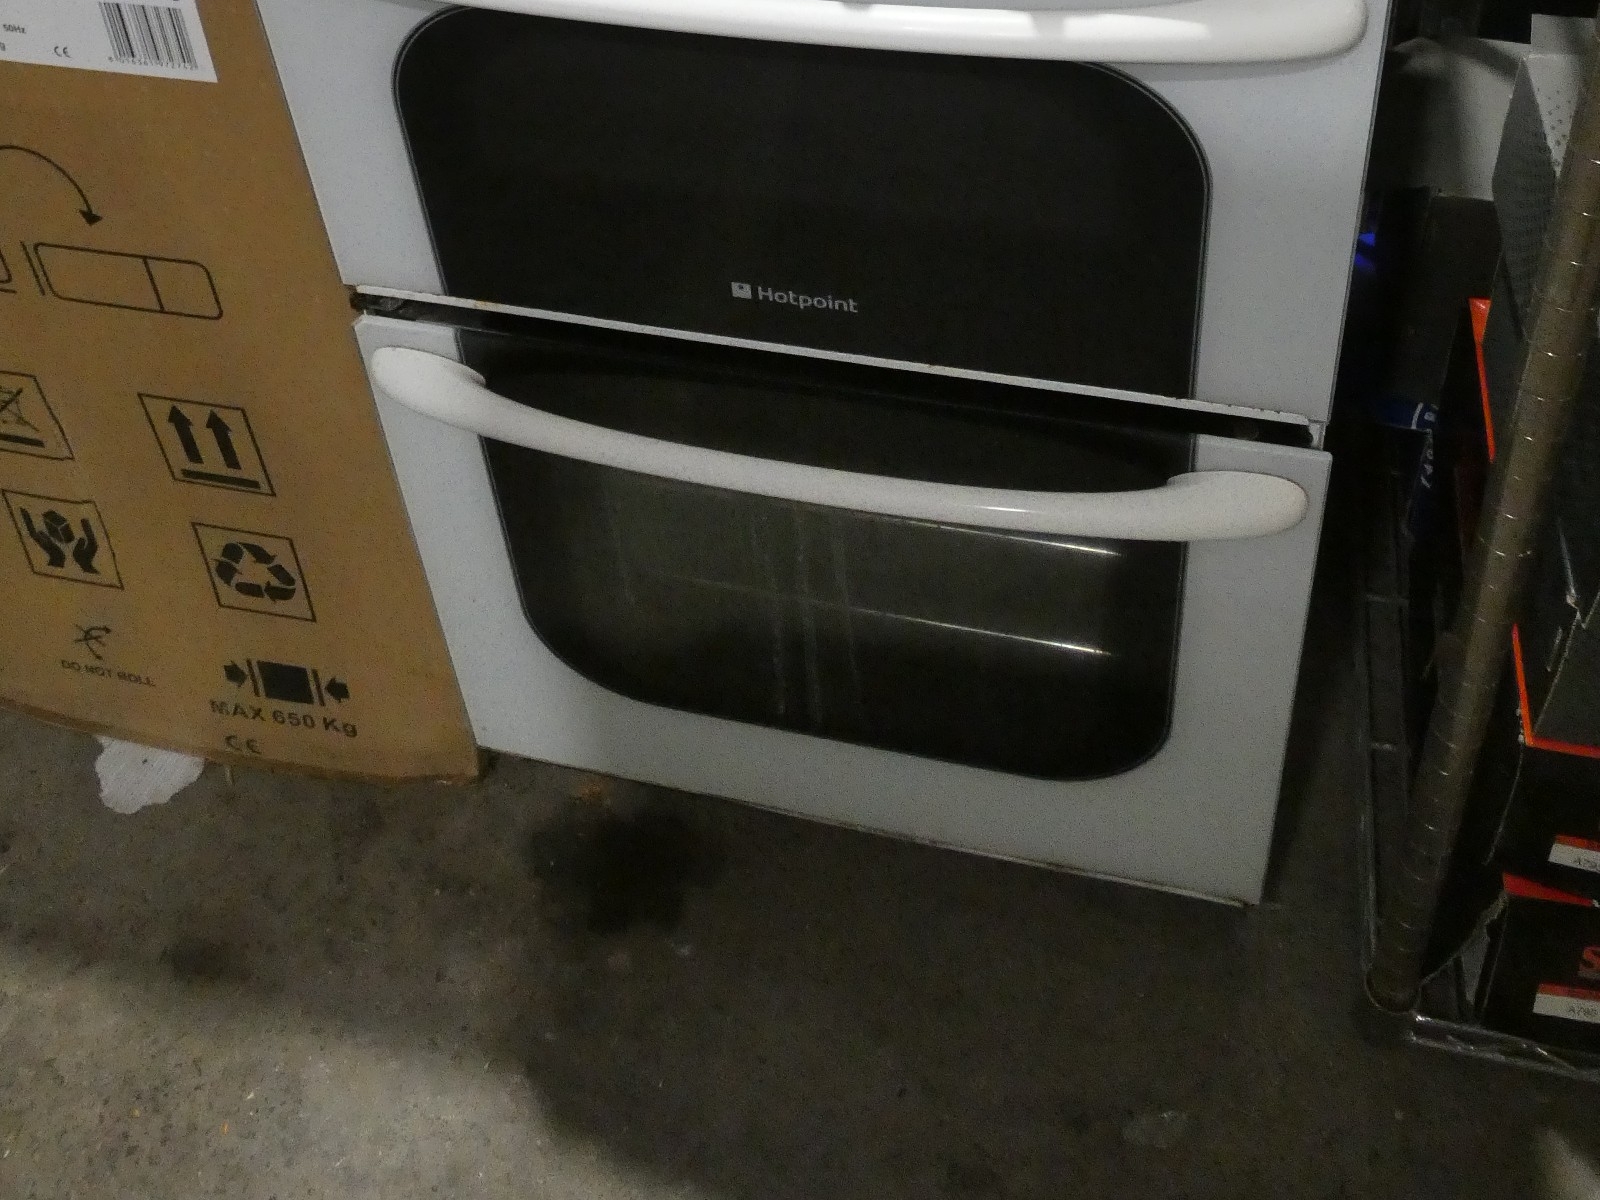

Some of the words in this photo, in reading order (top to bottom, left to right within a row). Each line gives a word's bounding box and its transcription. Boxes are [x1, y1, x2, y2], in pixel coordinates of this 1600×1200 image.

[758, 286, 859, 313] Hotpoint
[61, 660, 80, 671] DO
[210, 700, 266, 722] MAX
[272, 710, 316, 729] 650
[322, 715, 359, 738] Kg
